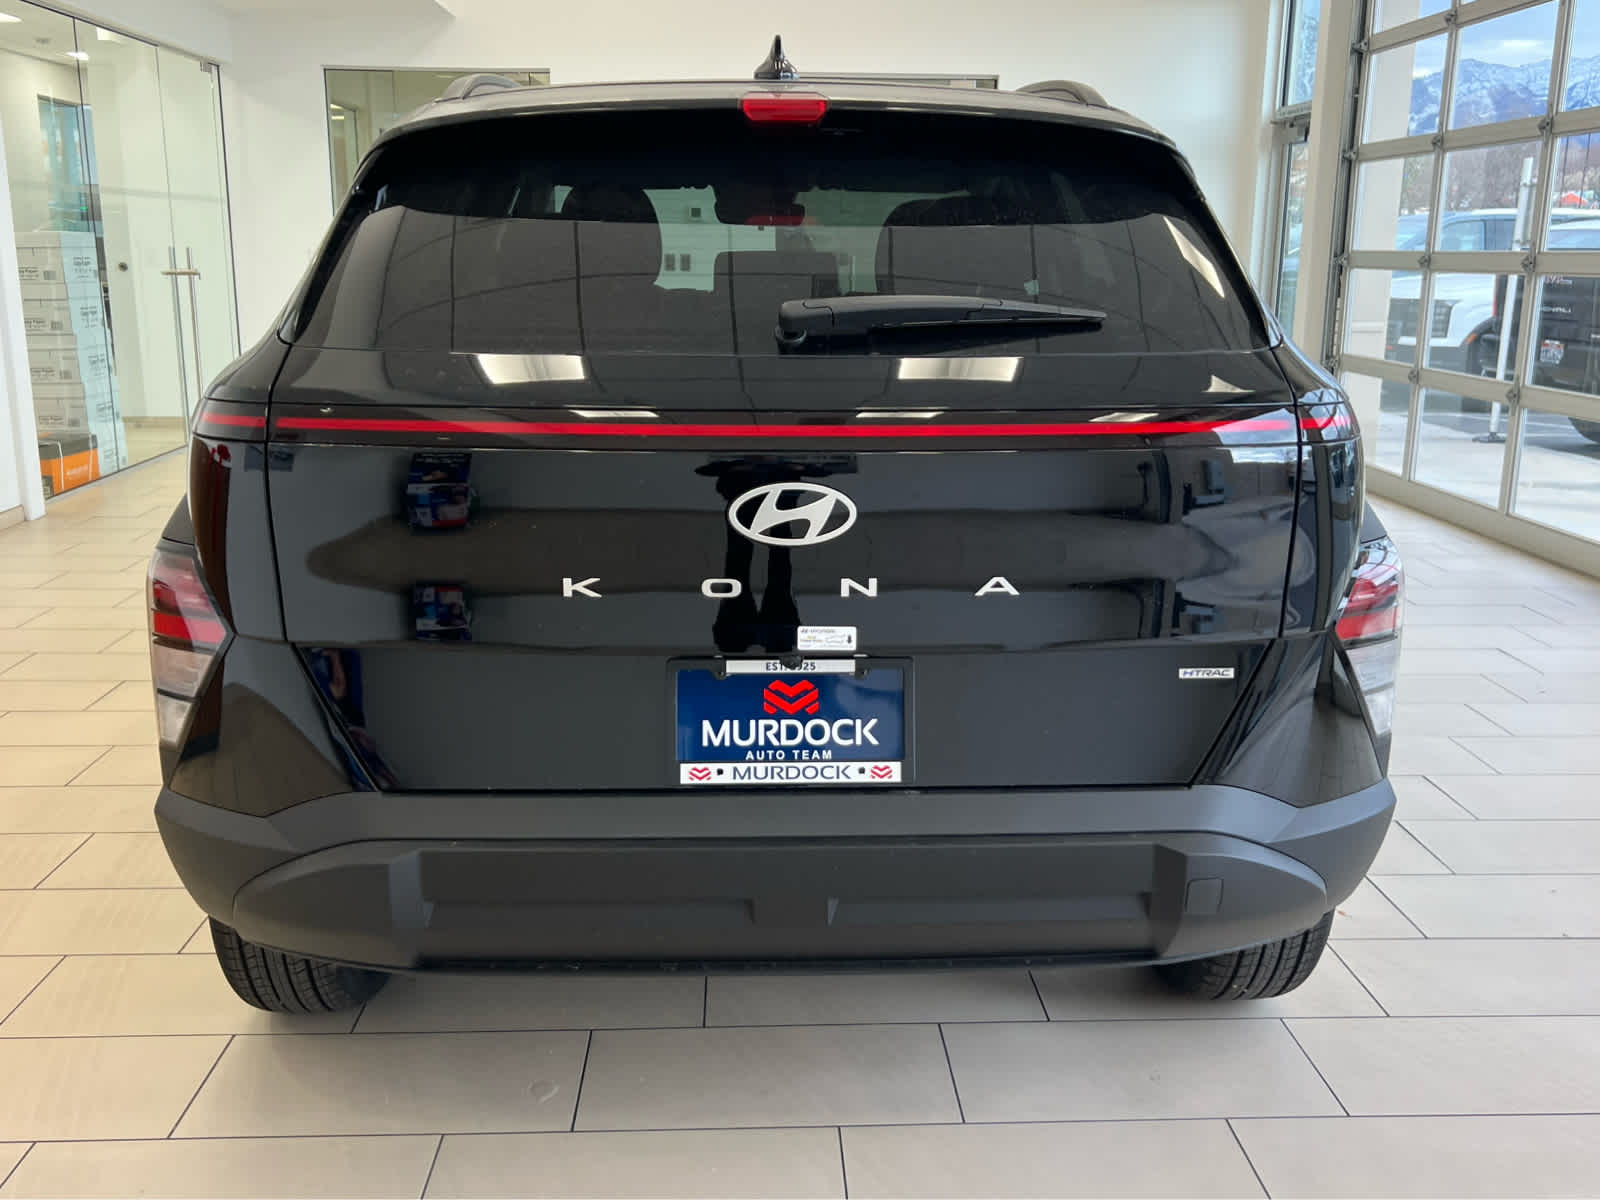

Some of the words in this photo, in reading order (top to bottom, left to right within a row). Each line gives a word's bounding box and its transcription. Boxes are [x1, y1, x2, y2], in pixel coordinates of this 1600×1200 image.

[562, 576, 1021, 598] KONA
[1182, 668, 1231, 677] HTRAC
[701, 718, 880, 747] MURDOCK
[745, 749, 785, 760] AUTO
[792, 749, 832, 760] TEAM
[732, 765, 852, 780] MURDOCK
